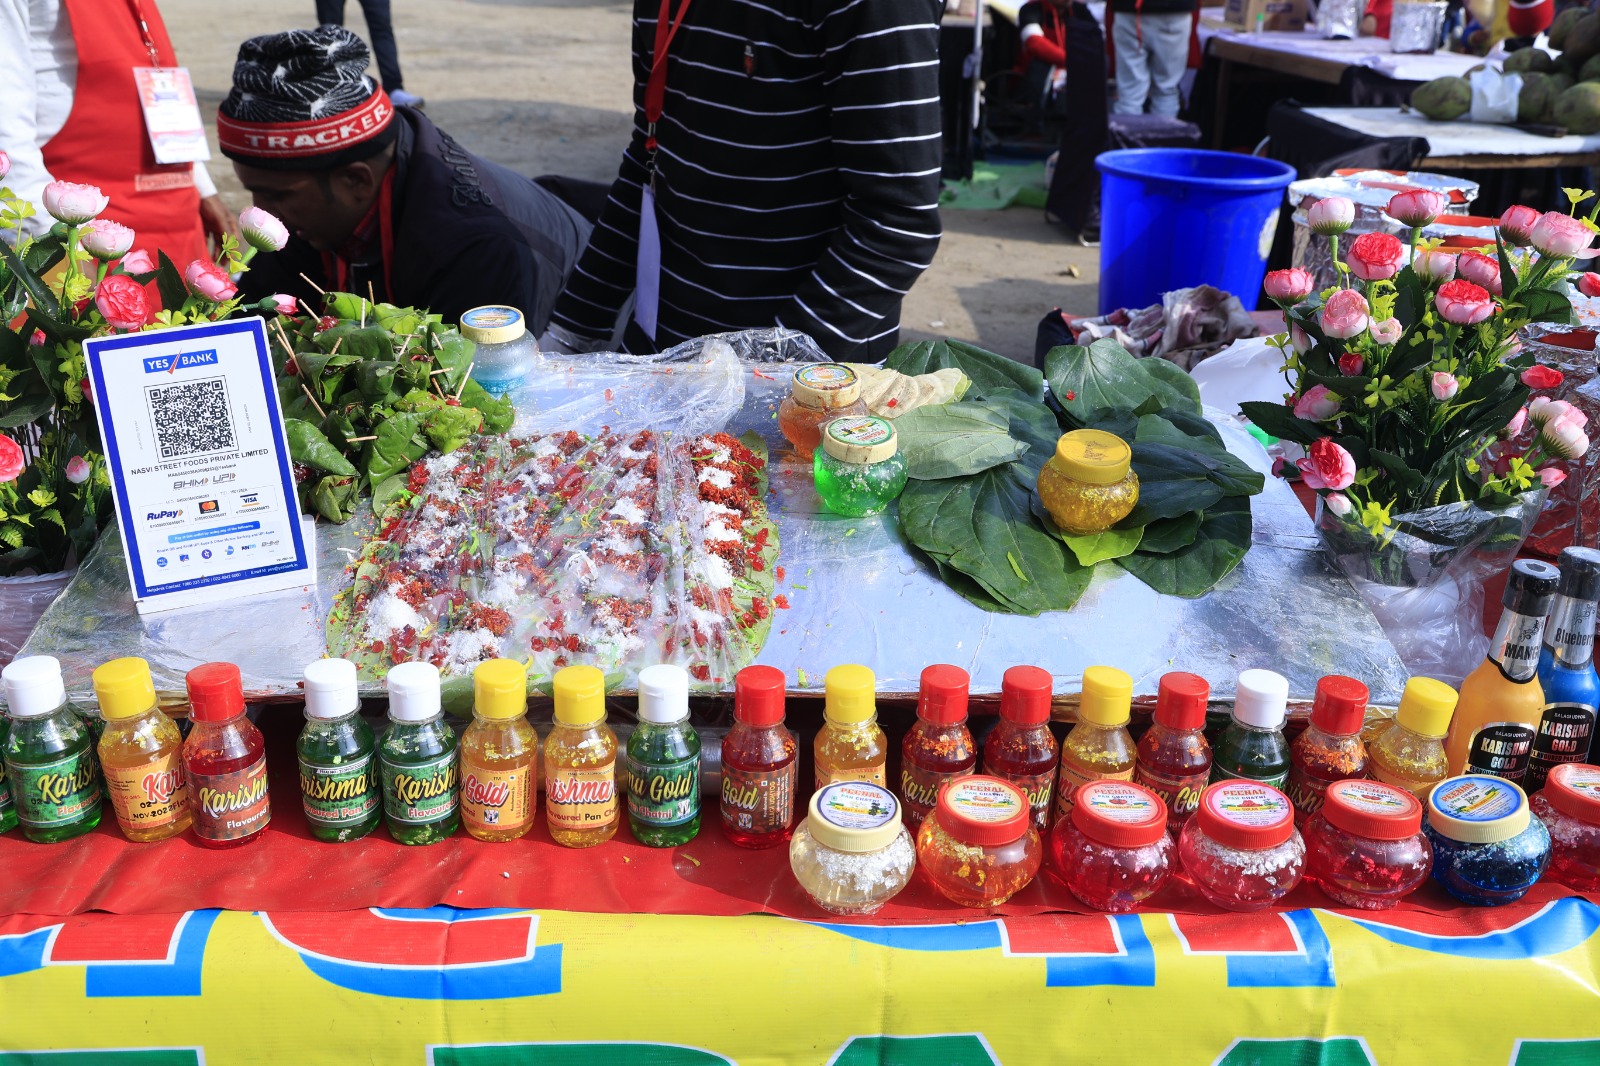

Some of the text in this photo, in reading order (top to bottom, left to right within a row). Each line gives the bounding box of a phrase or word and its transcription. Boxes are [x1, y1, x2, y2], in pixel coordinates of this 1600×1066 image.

[244, 103, 389, 149] TRACKER
[147, 353, 214, 370] YES BANK
[131, 465, 153, 475] NASVI
[154, 462, 182, 472] STREET
[183, 457, 208, 467] FOODS
[210, 452, 240, 462] PRIVATE
[241, 448, 269, 458] LIMITED
[173, 472, 233, 490] BHIM UPI
[242, 496, 258, 504] VISA
[147, 509, 179, 521] RuPay
[1504, 641, 1540, 661] MANG
[1540, 719, 1590, 739] KARISHMA
[1480, 737, 1530, 756] KARISHMA
[1551, 739, 1577, 753] GOLD
[1490, 756, 1517, 769] GOLD
[464, 773, 511, 808] Gold
[649, 770, 694, 804] Gold
[722, 776, 761, 811] Gold
[840, 787, 883, 799] PEENAL
[962, 784, 1005, 793] PEENAL
[1222, 788, 1267, 797] PEENAL
[1440, 780, 1476, 802] PEENAL
[341, 806, 363, 818] Pan
[408, 794, 456, 818] Flavoured
[639, 805, 674, 819] Chatni
[226, 805, 268, 829] Flavoured
[584, 813, 602, 821] Pan
